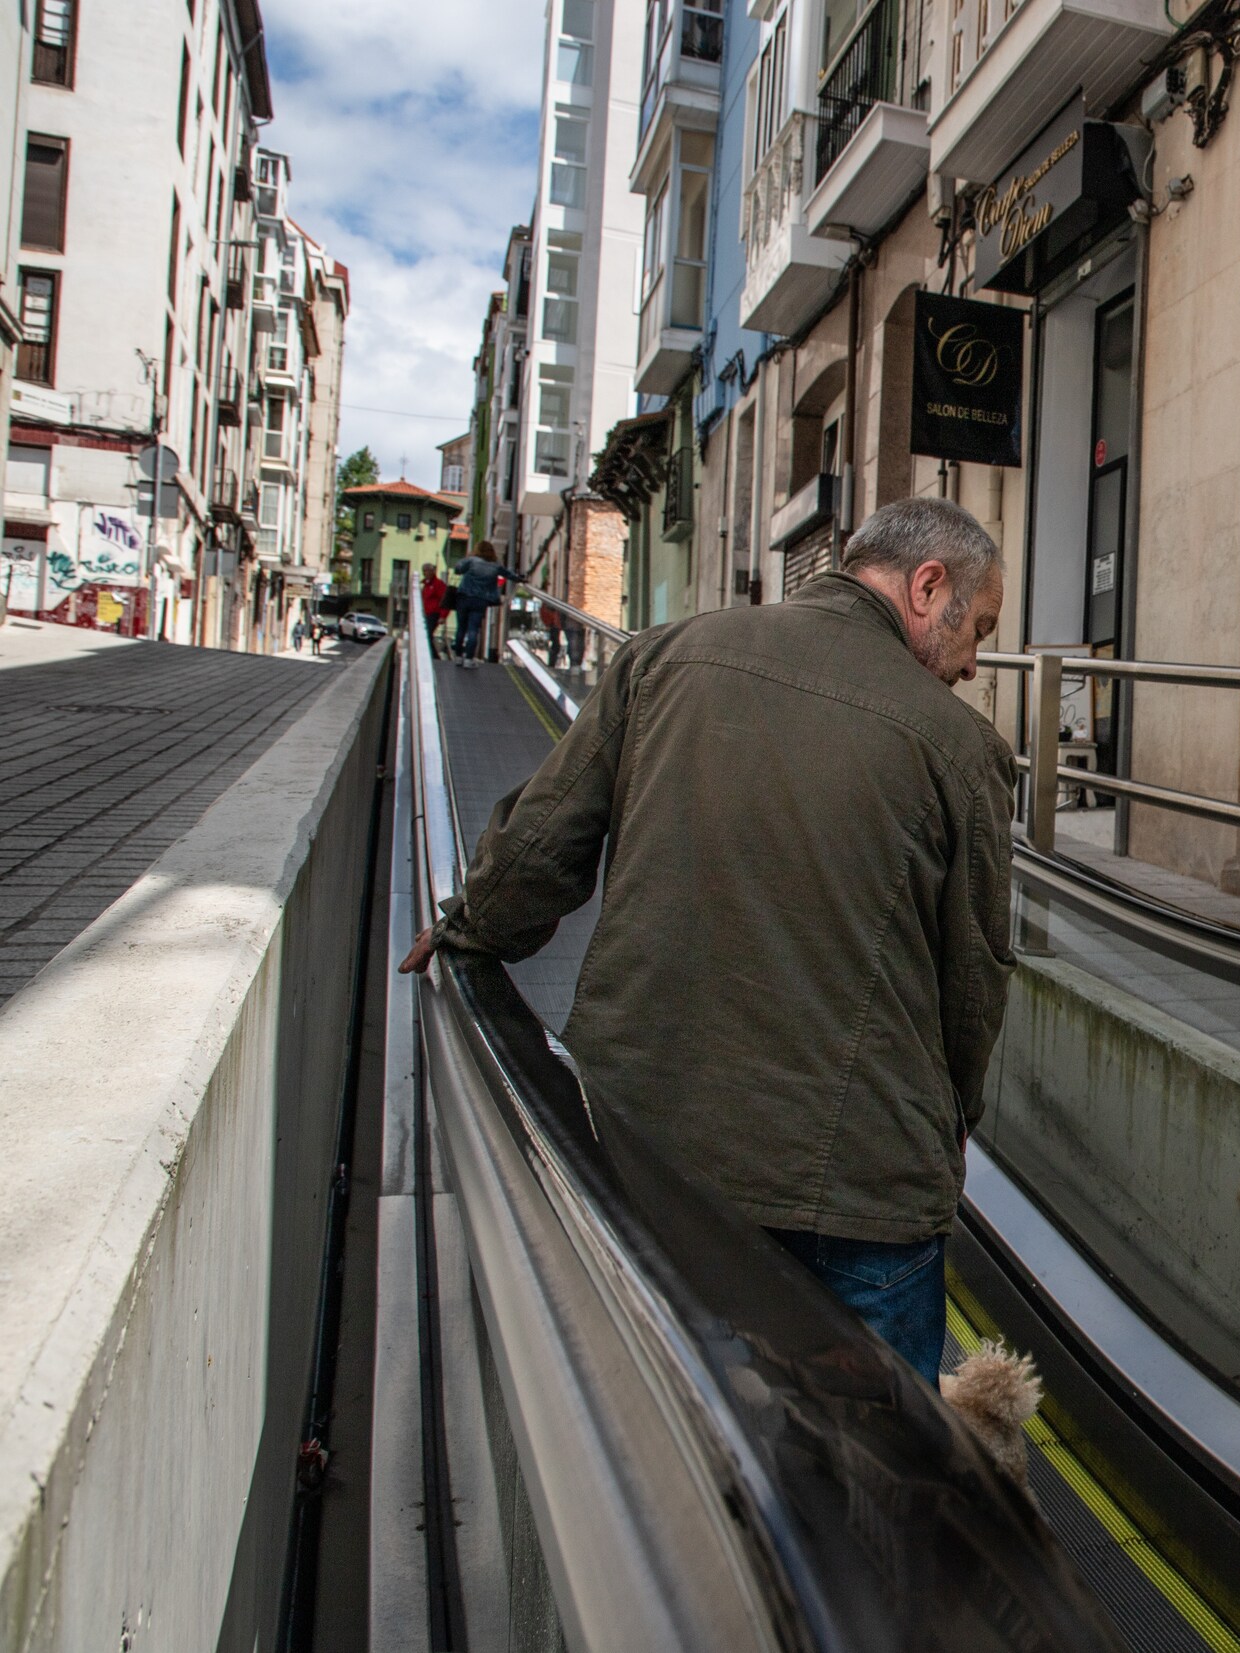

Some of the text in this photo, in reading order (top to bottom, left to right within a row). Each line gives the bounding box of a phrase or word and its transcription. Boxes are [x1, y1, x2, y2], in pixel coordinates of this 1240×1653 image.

[927, 402, 1009, 426] SALON DE BELLEZA
